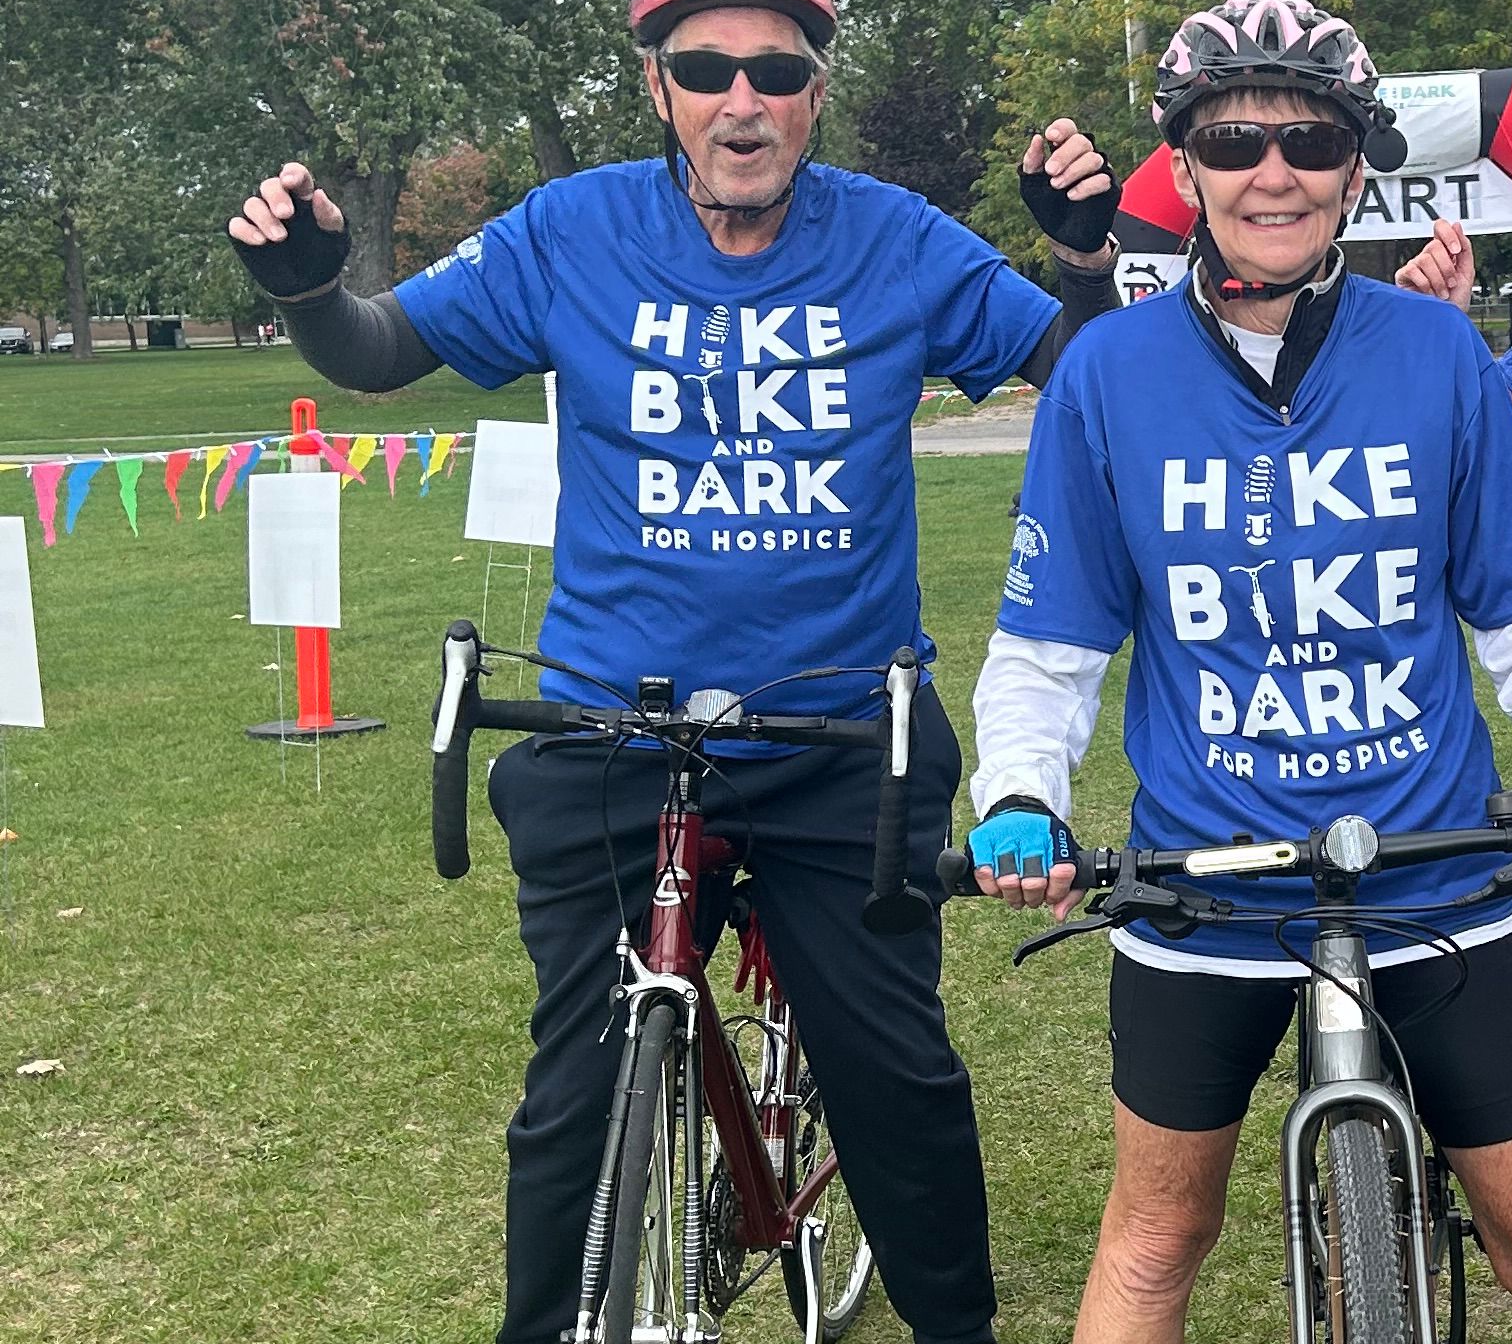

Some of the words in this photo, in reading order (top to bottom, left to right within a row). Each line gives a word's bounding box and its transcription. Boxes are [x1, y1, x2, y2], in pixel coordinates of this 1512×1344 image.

[1400, 84, 1456, 99] BARK
[1352, 173, 1480, 224] ART
[712, 439, 773, 456] AND
[639, 460, 850, 514] BARK
[642, 527, 690, 549] FOR
[713, 529, 851, 551] HOSPICE
[1266, 642, 1337, 666] AND
[1199, 656, 1421, 737] BARK
[1207, 743, 1253, 777] FOR
[1279, 728, 1429, 778] HOSPICE
[1058, 829, 1069, 859] GIRO
